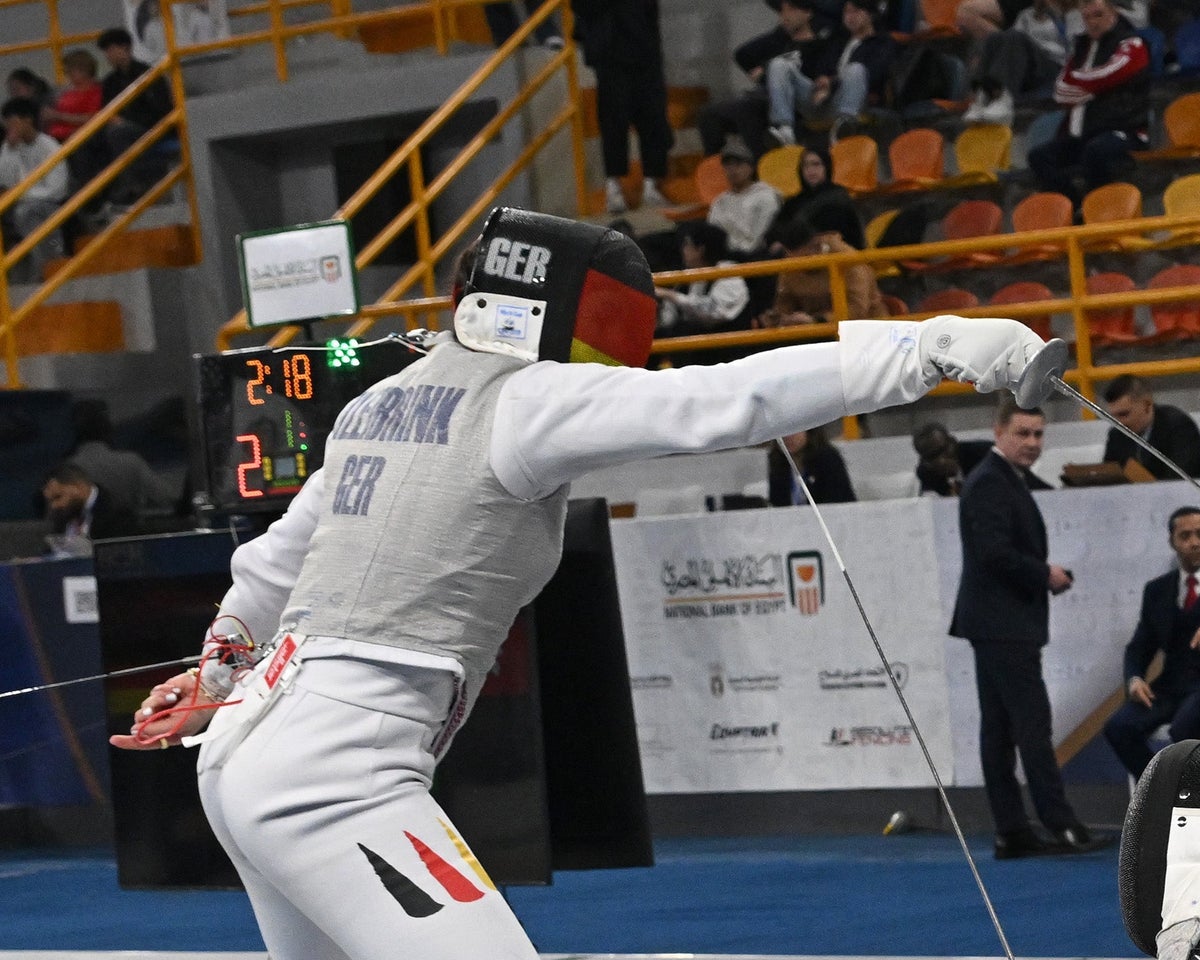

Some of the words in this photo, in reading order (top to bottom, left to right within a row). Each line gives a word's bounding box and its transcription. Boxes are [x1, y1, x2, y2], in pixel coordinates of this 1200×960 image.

[484, 237, 551, 284] GER
[246, 354, 313, 405] 2:18
[236, 434, 264, 498] 2
[332, 454, 387, 516] GER
